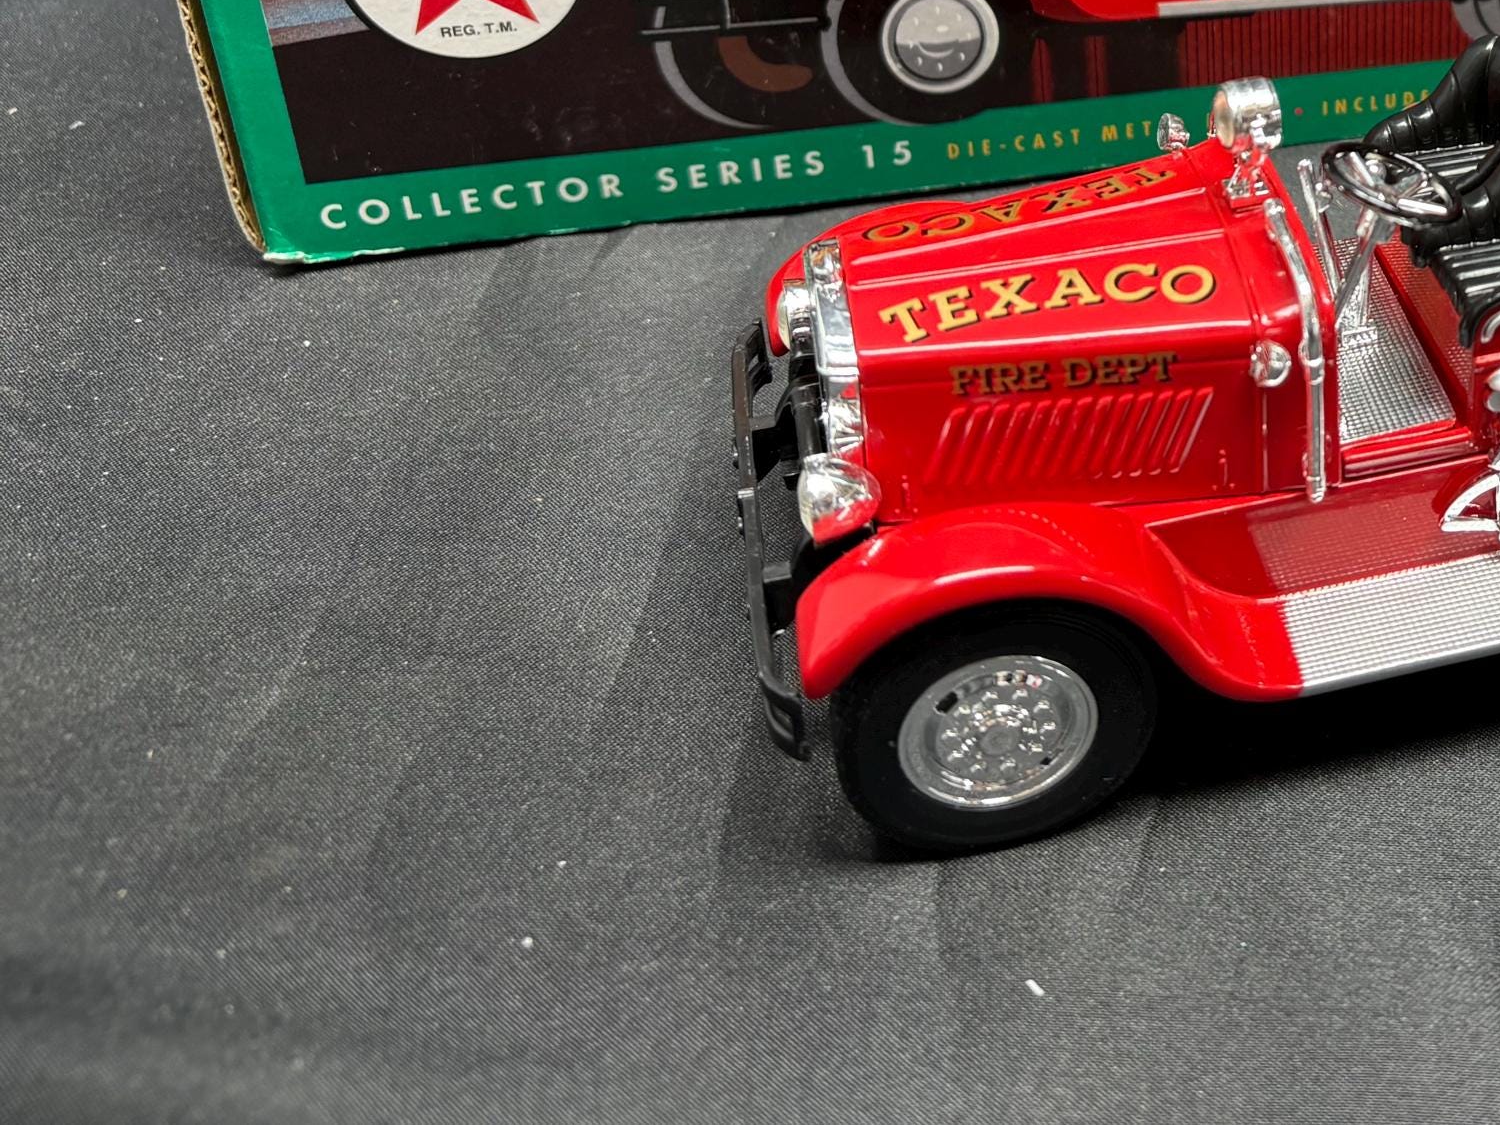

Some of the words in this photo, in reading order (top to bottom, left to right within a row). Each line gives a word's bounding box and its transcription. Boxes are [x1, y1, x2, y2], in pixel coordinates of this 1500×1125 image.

[440, 22, 481, 38] REG.
[484, 20, 518, 35] T.M.
[320, 173, 625, 231] COLLECTOR
[657, 150, 826, 193] SERIES
[861, 139, 913, 169] 15
[946, 127, 1082, 161] DIE-CAST
[862, 166, 1179, 243] TEXACO
[878, 262, 1219, 345] TEXACO
[948, 357, 1053, 396] FIRE
[1061, 350, 1180, 388] DEPT
